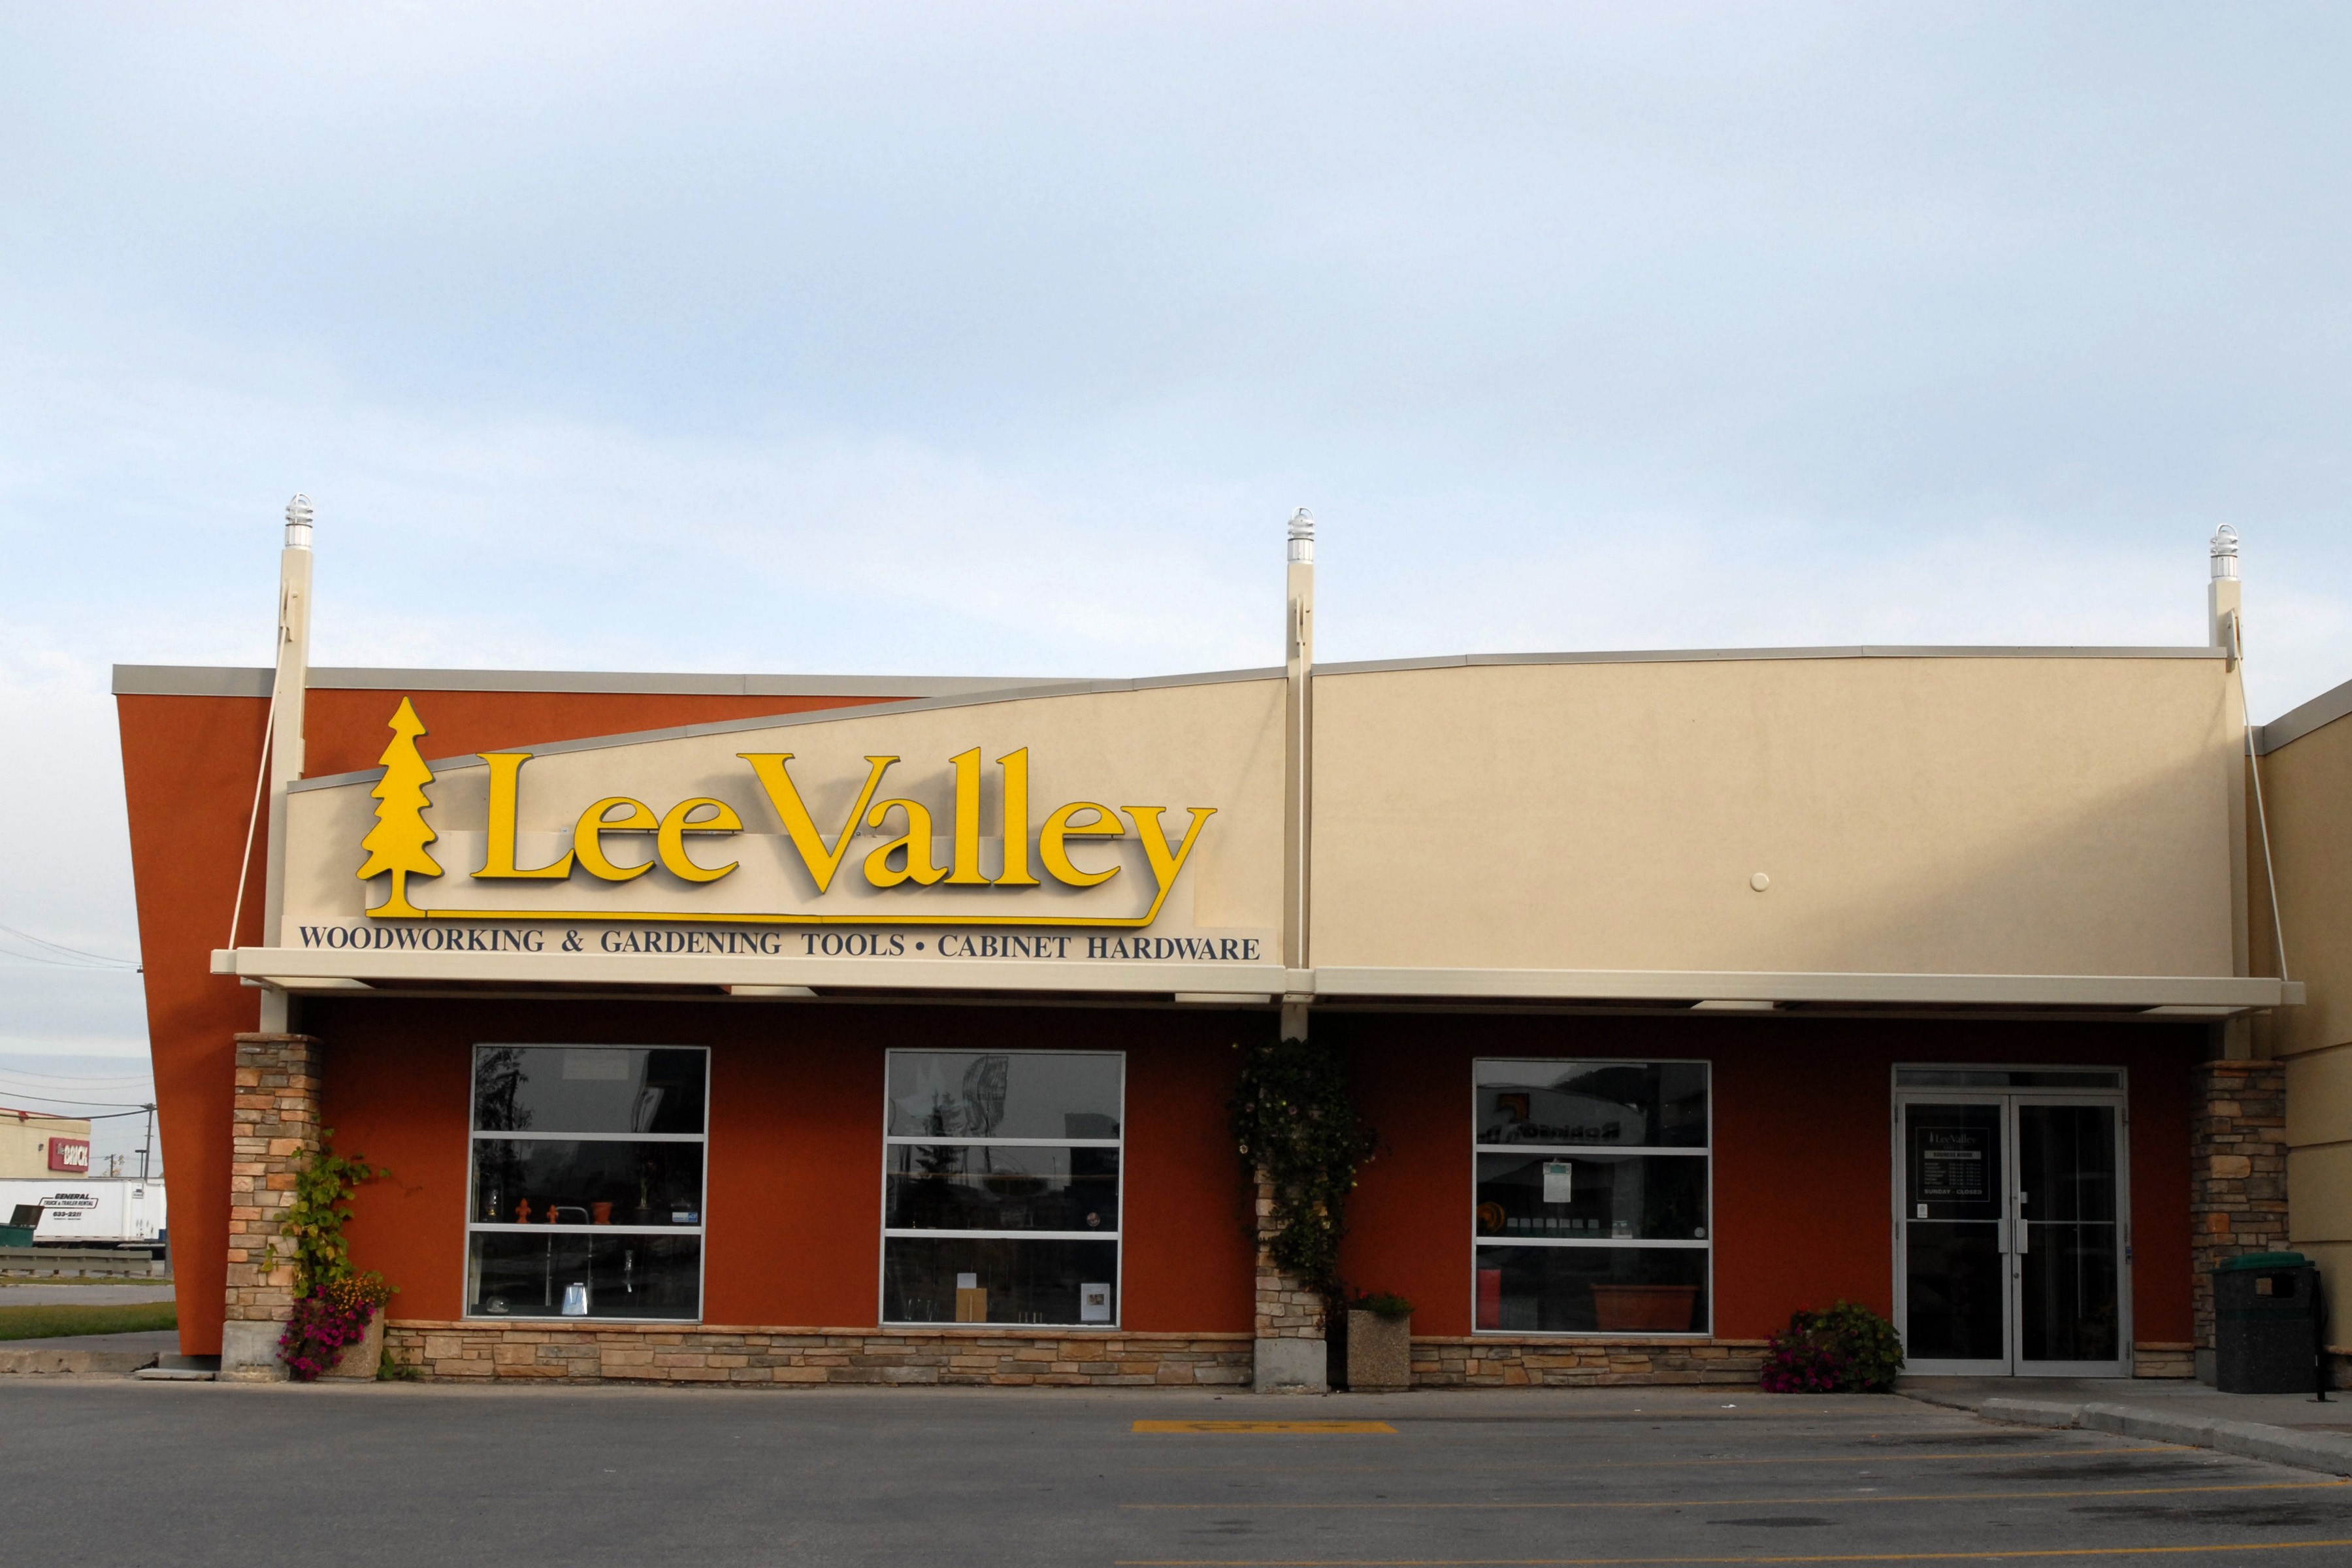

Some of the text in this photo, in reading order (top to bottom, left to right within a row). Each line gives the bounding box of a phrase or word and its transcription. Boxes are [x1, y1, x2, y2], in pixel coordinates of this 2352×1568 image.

[470, 746, 1218, 927] Lee Valley
[299, 926, 1260, 961] WOODWORKING & GARDENING TOOLS CABINET HARDWARE
[63, 1145, 88, 1166] BRICK
